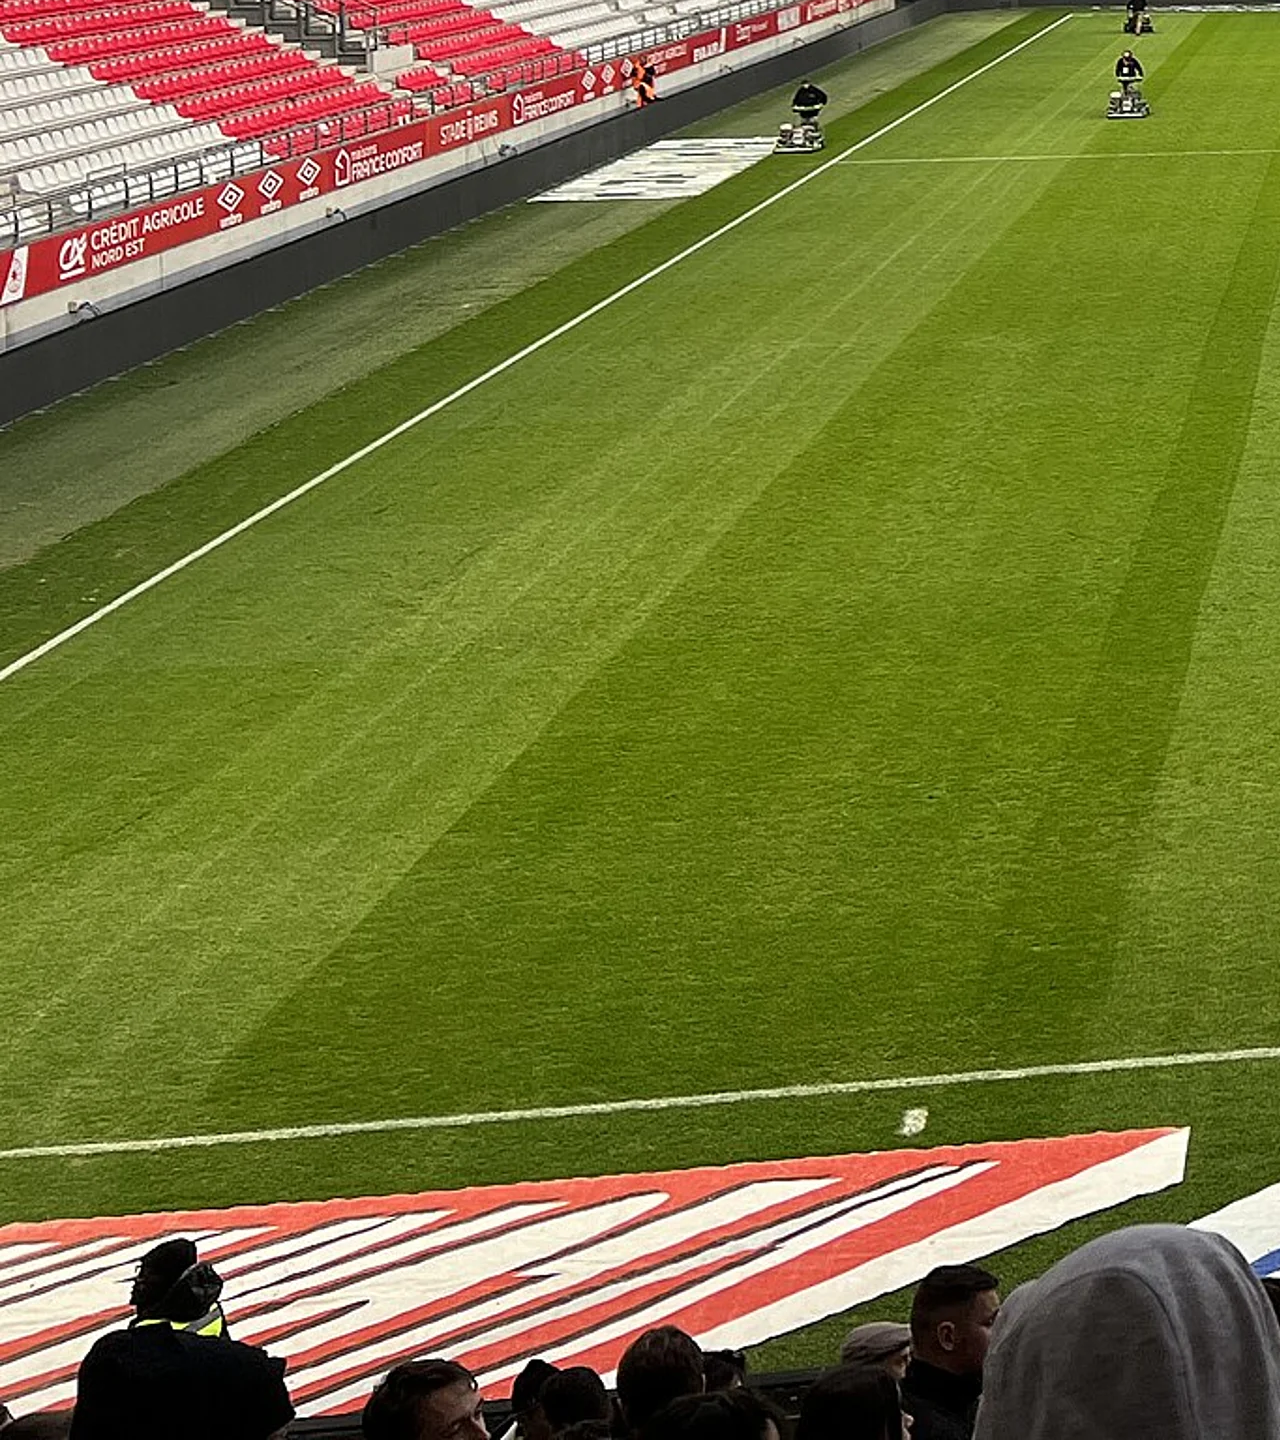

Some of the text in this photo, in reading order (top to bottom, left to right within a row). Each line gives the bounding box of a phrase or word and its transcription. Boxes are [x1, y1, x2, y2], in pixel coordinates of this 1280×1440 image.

[440, 109, 499, 146] STADE REIMS
[351, 143, 378, 161] maisons
[352, 141, 424, 182] FRANCE CONFORT
[90, 197, 205, 251] CRÉDIT AGRICOLE
[91, 237, 146, 269] NORD EST
